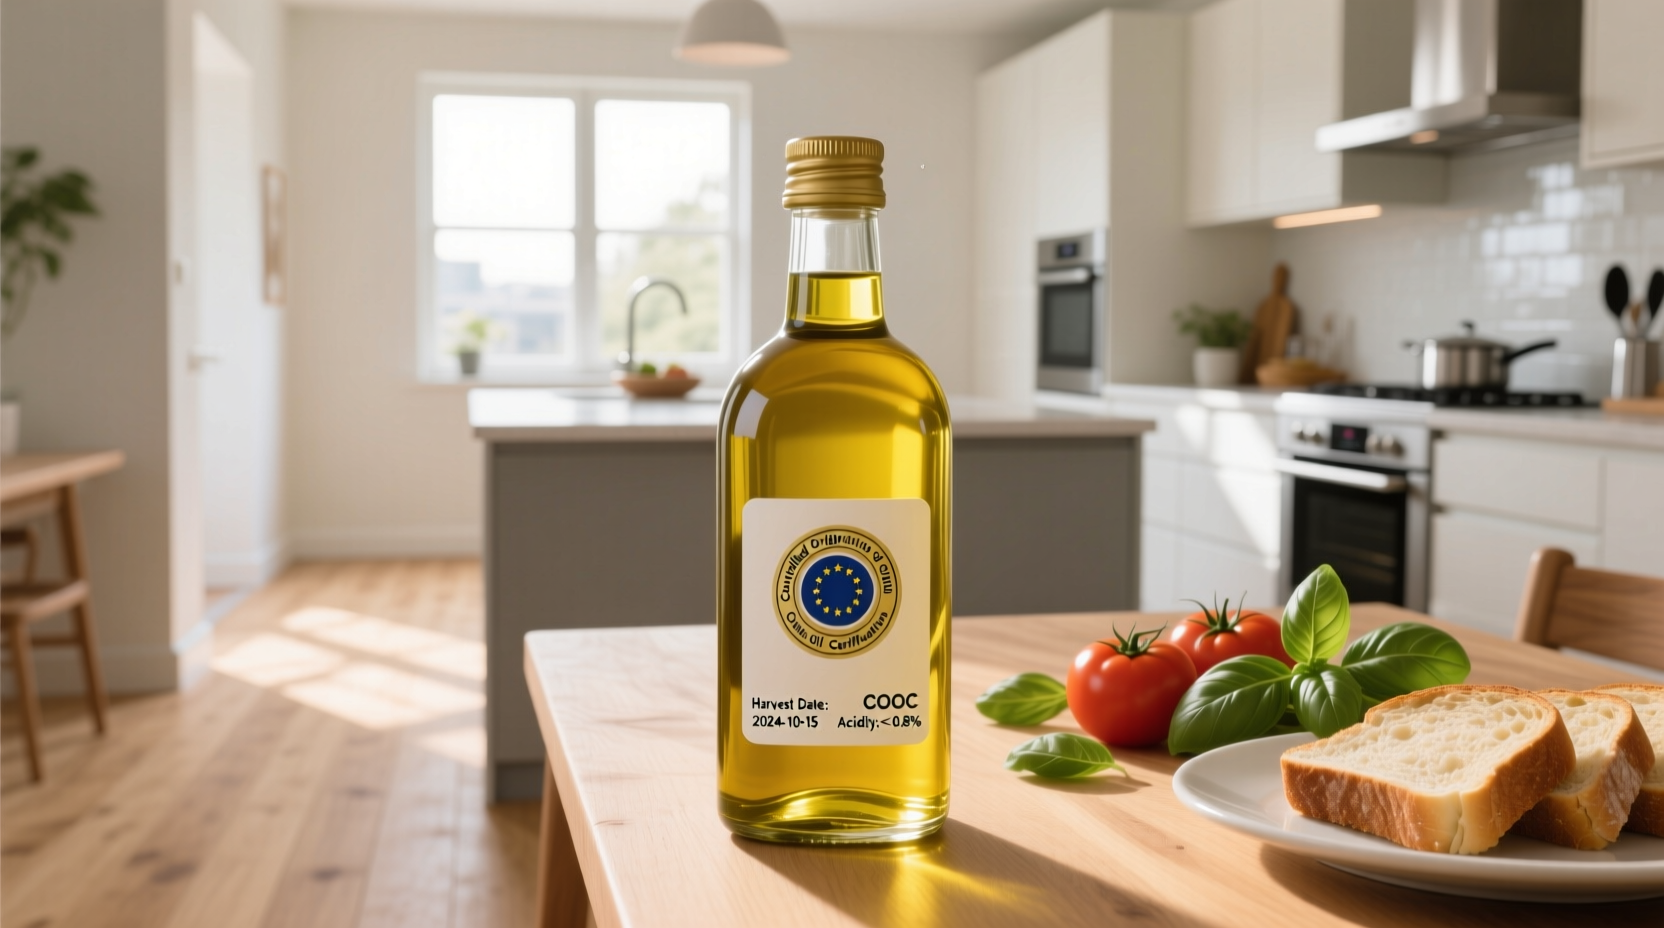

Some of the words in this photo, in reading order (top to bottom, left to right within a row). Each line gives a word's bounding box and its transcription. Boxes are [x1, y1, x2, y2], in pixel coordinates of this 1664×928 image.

[752, 697, 793, 710] Harvest
[863, 692, 919, 710] COOC
[752, 715, 819, 728] 2024-10-15
